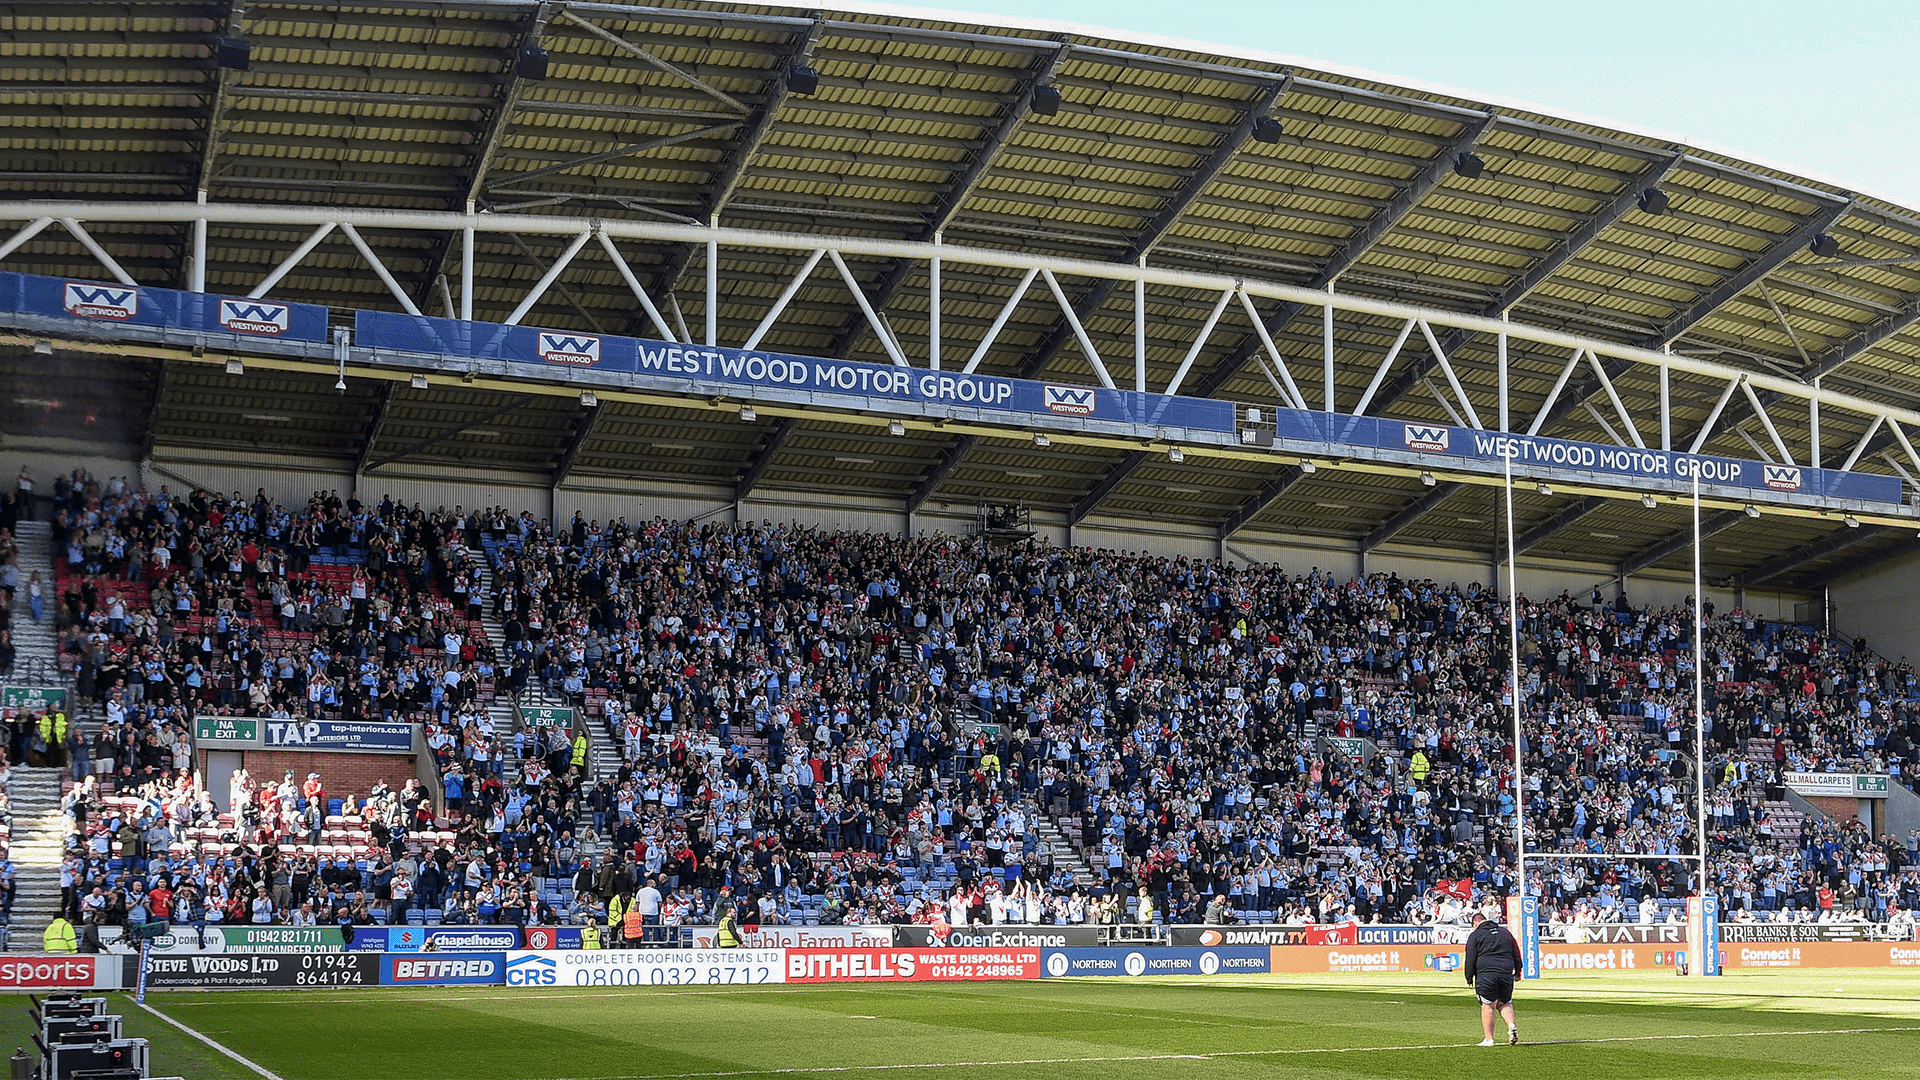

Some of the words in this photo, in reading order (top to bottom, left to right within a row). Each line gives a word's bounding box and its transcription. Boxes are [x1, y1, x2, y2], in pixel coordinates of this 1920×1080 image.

[76, 307, 126, 318] WESTWOOD
[230, 322, 278, 333] WESTWOOD
[547, 353, 591, 364] WESTWOOD
[638, 345, 808, 384] WESTWOOD
[815, 363, 910, 395] MOTOR
[919, 375, 1012, 403] GROUP
[1051, 404, 1088, 414] WESTWOOD
[1411, 441, 1443, 450] WESTWOOD
[1474, 434, 1595, 467] WESTWOOD
[1600, 449, 1669, 475] MOTOR
[1675, 458, 1742, 482] GROUP
[540, 710, 552, 718] N2
[219, 721, 234, 729] NA
[536, 718, 555, 726] EXIT
[215, 730, 238, 739] EXIT
[267, 722, 320, 747] TAP
[331, 724, 410, 735] tap-interiors.co.uk
[1786, 775, 1797, 784] ALL
[1799, 775, 1818, 784] MALL
[1818, 776, 1851, 785] CARPETS
[247, 931, 279, 943] 01942
[282, 931, 300, 943] 821
[304, 931, 322, 942] 711
[1358, 930, 1391, 944] LOCH
[1394, 930, 1435, 944] LOMON
[1747, 926, 1754, 937] R
[1756, 926, 1788, 937] BANKS
[1799, 926, 1819, 937] SON
[179, 936, 219, 945] COMANY
[435, 934, 512, 948] chapelhouse
[797, 932, 845, 948] Farm
[851, 932, 890, 948] Fare
[950, 931, 1066, 947] OpenExchange
[1226, 931, 1307, 945] DAVANTI.TY
[226, 944, 342, 953] WWWWIGANBEERCOUK
[1526, 916, 1536, 977] BETFRED
[1706, 915, 1715, 974] BETFRED
[566, 954, 633, 965] COMPLETE
[637, 953, 693, 964] ROOFING
[696, 953, 753, 963] SYSTEMS
[757, 952, 779, 963] LTD
[919, 954, 957, 964] WASTE
[960, 954, 1014, 964] DISPOSAL
[1017, 953, 1037, 964] LTD
[1328, 951, 1387, 965] Connect
[1621, 949, 1635, 969] it
[1741, 948, 1790, 960] Connect
[147, 957, 187, 974] STEVE
[191, 956, 248, 974] WOODS
[251, 956, 279, 974] LTD
[302, 955, 358, 969] 01942
[788, 953, 916, 978] BITHELL'S
[1072, 959, 1117, 969] NORTHERN
[1149, 959, 1192, 969] NORTHERN
[1222, 958, 1265, 967] NORTHERN
[1, 961, 90, 984] sports
[396, 960, 495, 978] BETFRED
[932, 965, 973, 977] 01942
[976, 965, 1024, 976] 248965
[154, 977, 202, 986] Undercarriage
[229, 977, 268, 985] Engineering
[296, 971, 363, 985] 864194
[508, 969, 556, 985] CRS
[576, 968, 640, 986] 0800
[651, 967, 696, 985] 032
[708, 967, 769, 985] 8712
